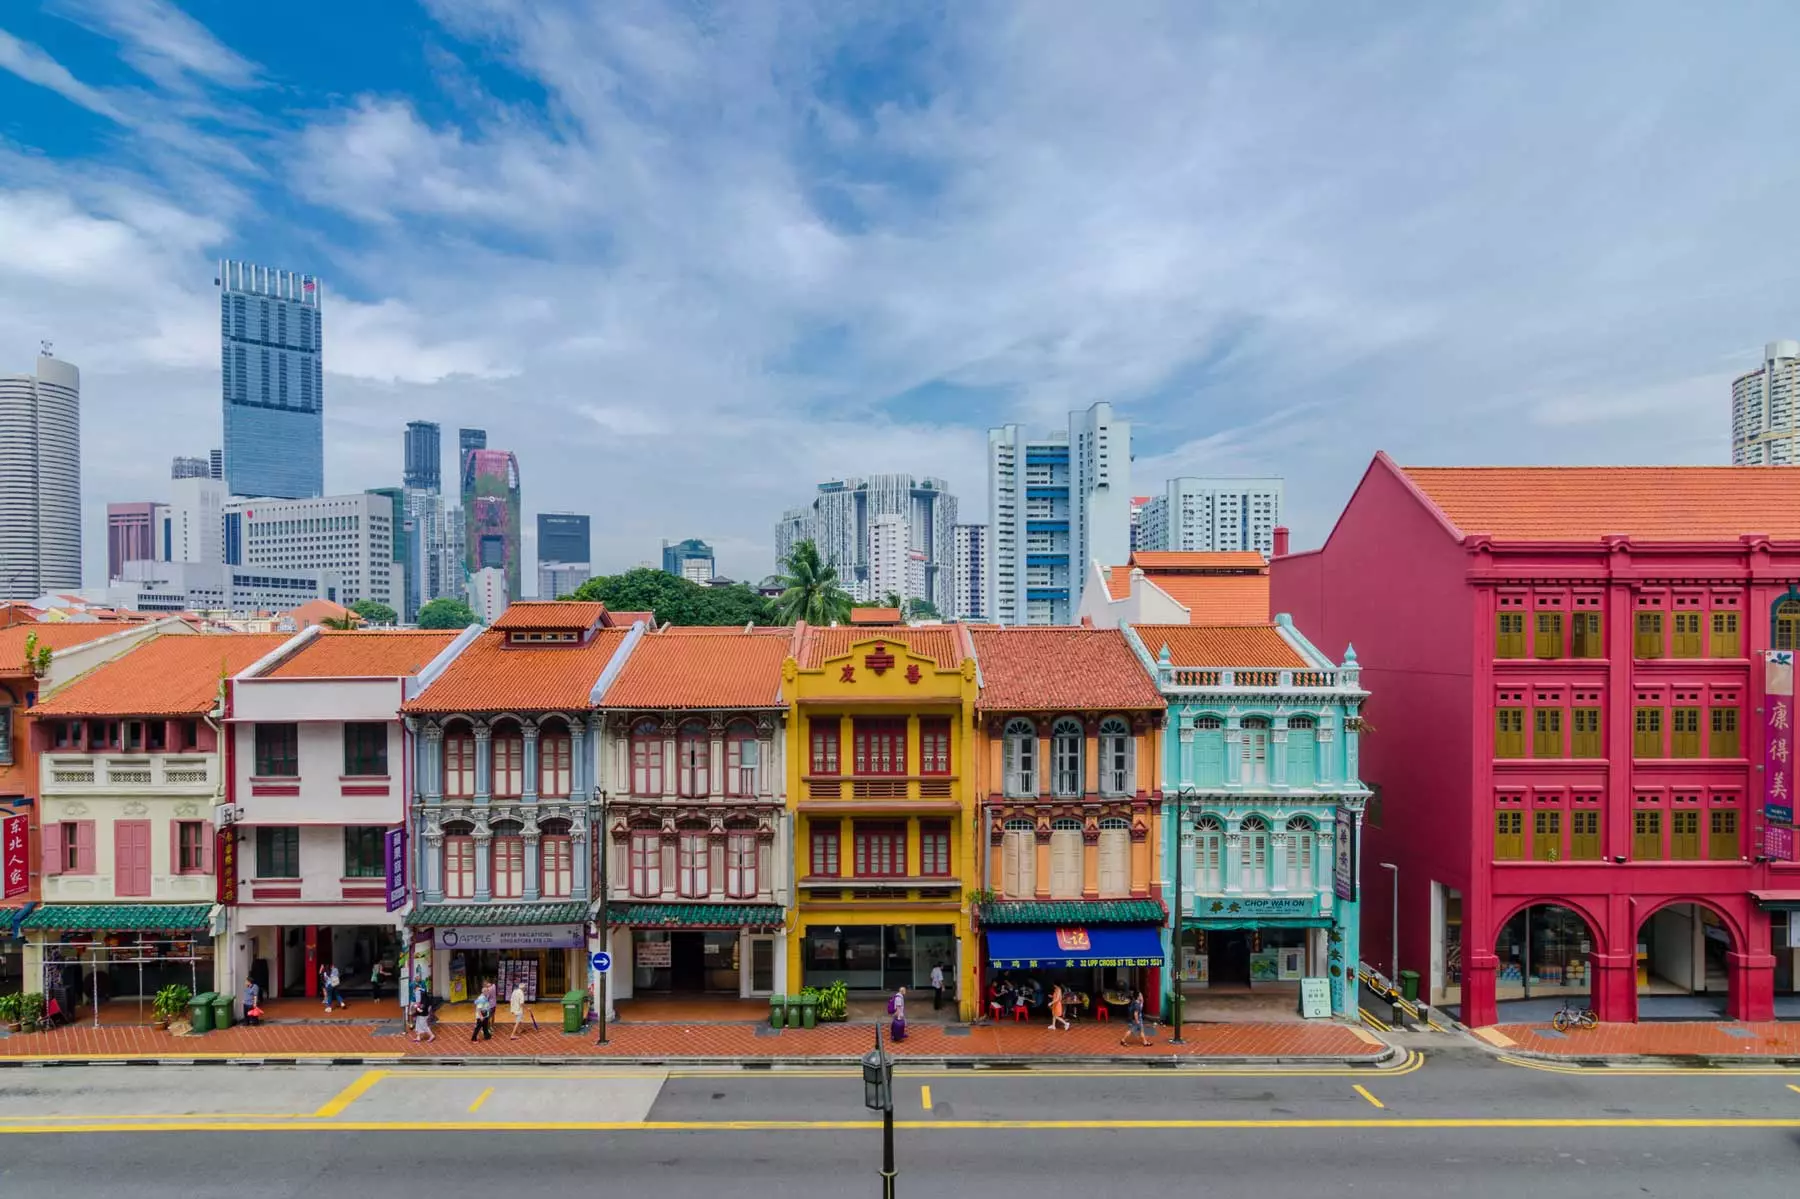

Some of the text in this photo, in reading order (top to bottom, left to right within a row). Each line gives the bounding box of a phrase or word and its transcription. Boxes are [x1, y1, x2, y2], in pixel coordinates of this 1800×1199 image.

[1769, 702, 1789, 799] 康得美
[9, 819, 24, 885] 东北人家
[459, 934, 492, 943] APPLE
[1099, 959, 1116, 967] CROSS
[1117, 959, 1124, 967] ST
